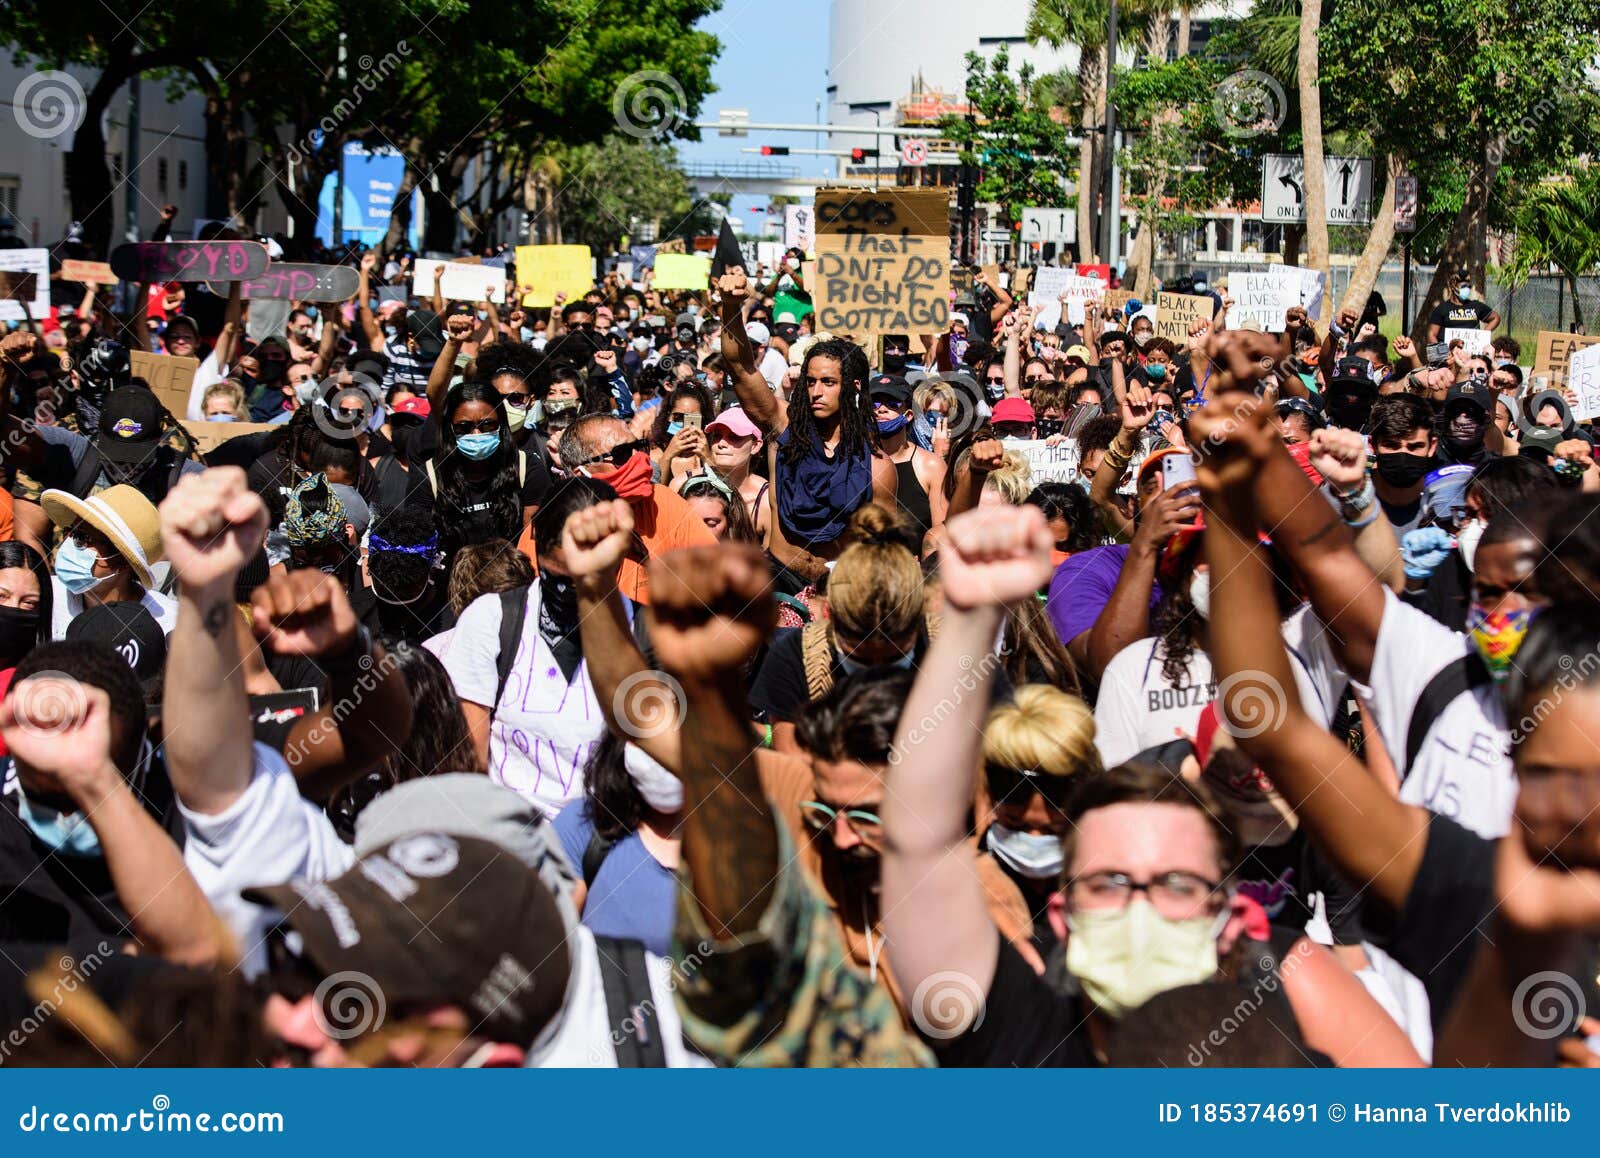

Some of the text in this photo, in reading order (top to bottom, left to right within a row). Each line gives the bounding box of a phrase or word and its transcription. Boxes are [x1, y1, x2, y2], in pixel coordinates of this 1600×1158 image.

[817, 199, 897, 225] COPS
[1277, 206, 1304, 217] ONLY
[1330, 207, 1358, 219] ONLY
[836, 224, 923, 253] That
[817, 253, 943, 282] DNT DO
[827, 278, 934, 305] RIGHT
[1247, 276, 1289, 291] BLACK
[1159, 294, 1197, 312] BLACK
[1240, 292, 1282, 306] LIVES
[820, 298, 948, 329] GOTTA GO
[1172, 311, 1200, 322] LIVES
[1238, 310, 1284, 324] MATTER
[1157, 320, 1189, 337] MATT
[1046, 445, 1079, 463] THIN
